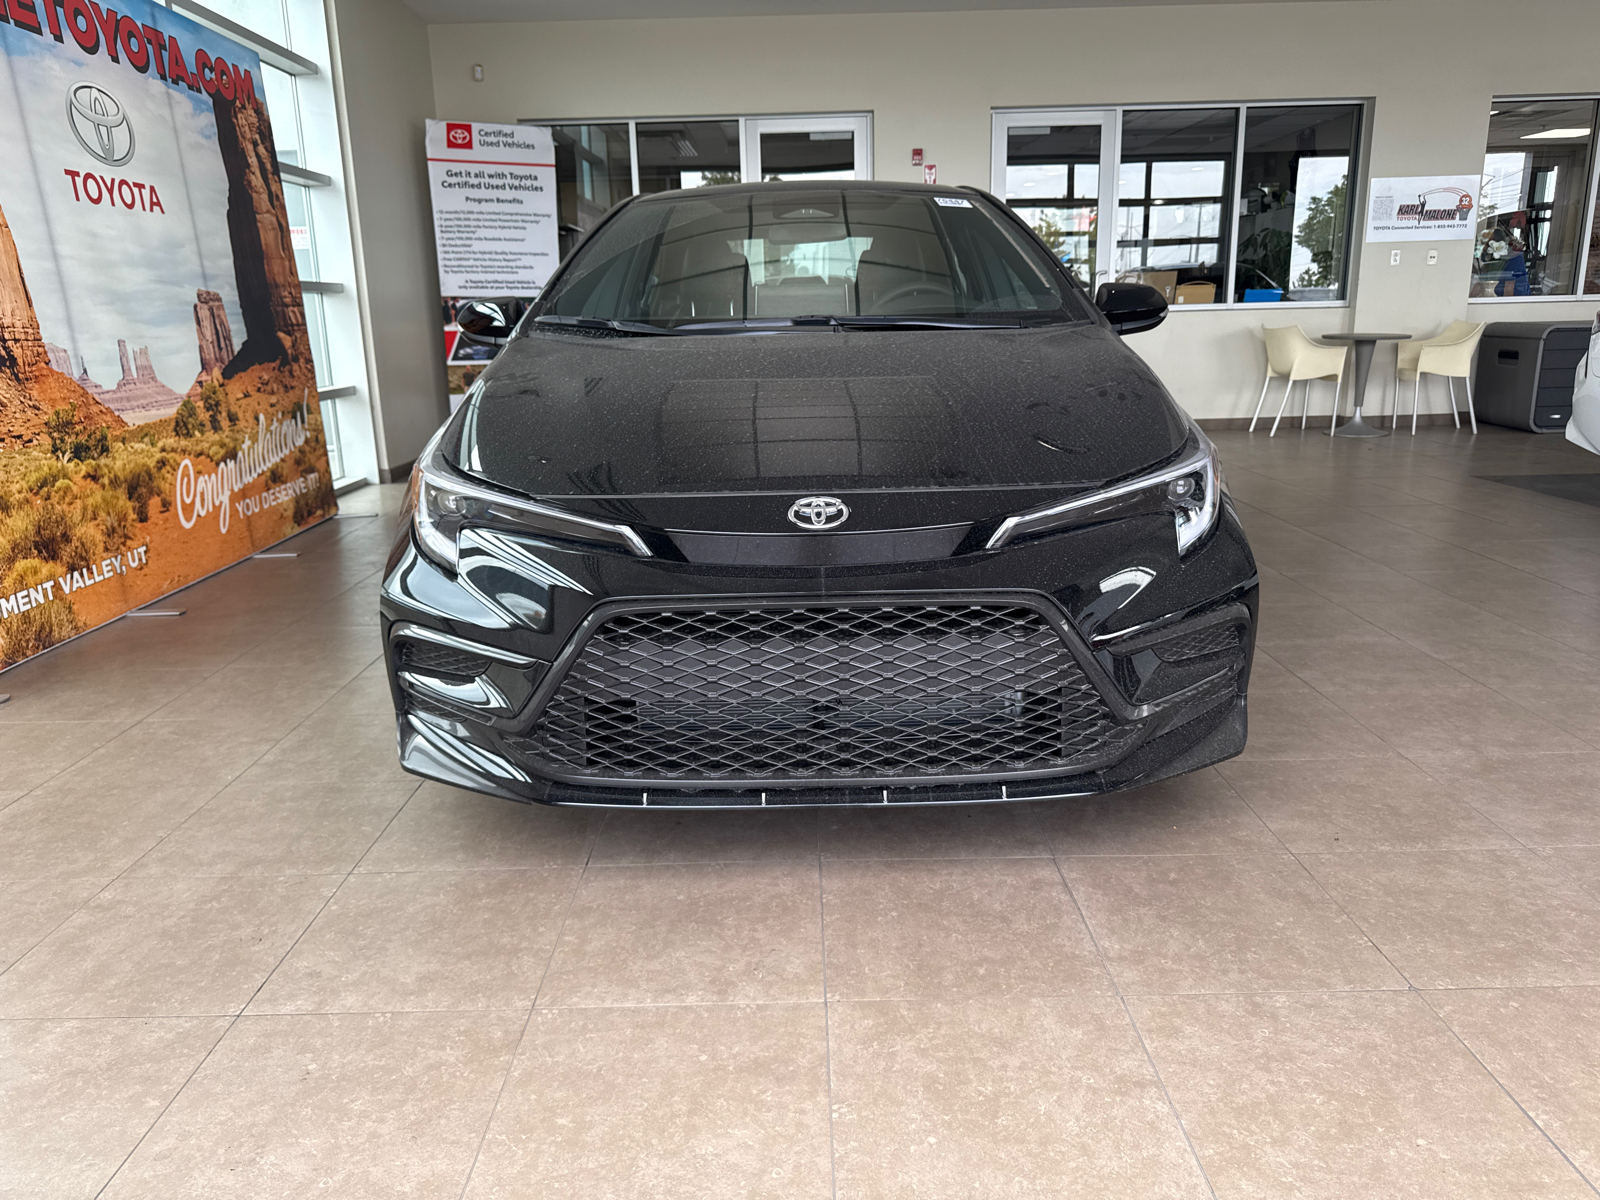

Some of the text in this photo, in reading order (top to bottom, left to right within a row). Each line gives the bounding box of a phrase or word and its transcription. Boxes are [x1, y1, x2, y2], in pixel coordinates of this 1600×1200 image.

[0, 0, 257, 109] ETOYOTA.COM
[478, 129, 514, 139] Certified
[479, 139, 535, 150] Used Vehicles
[446, 169, 538, 182] Get it all with Toyota
[63, 168, 165, 214] TOYOTA
[441, 180, 544, 192] Certified Used Vehicles
[465, 196, 495, 204] Program
[1397, 204, 1457, 221] KARL MALONE
[176, 387, 311, 535] Congratulations!
[235, 472, 320, 519] YOU DESERVE IT!
[0, 545, 147, 619] MENT VALLEY, UT
